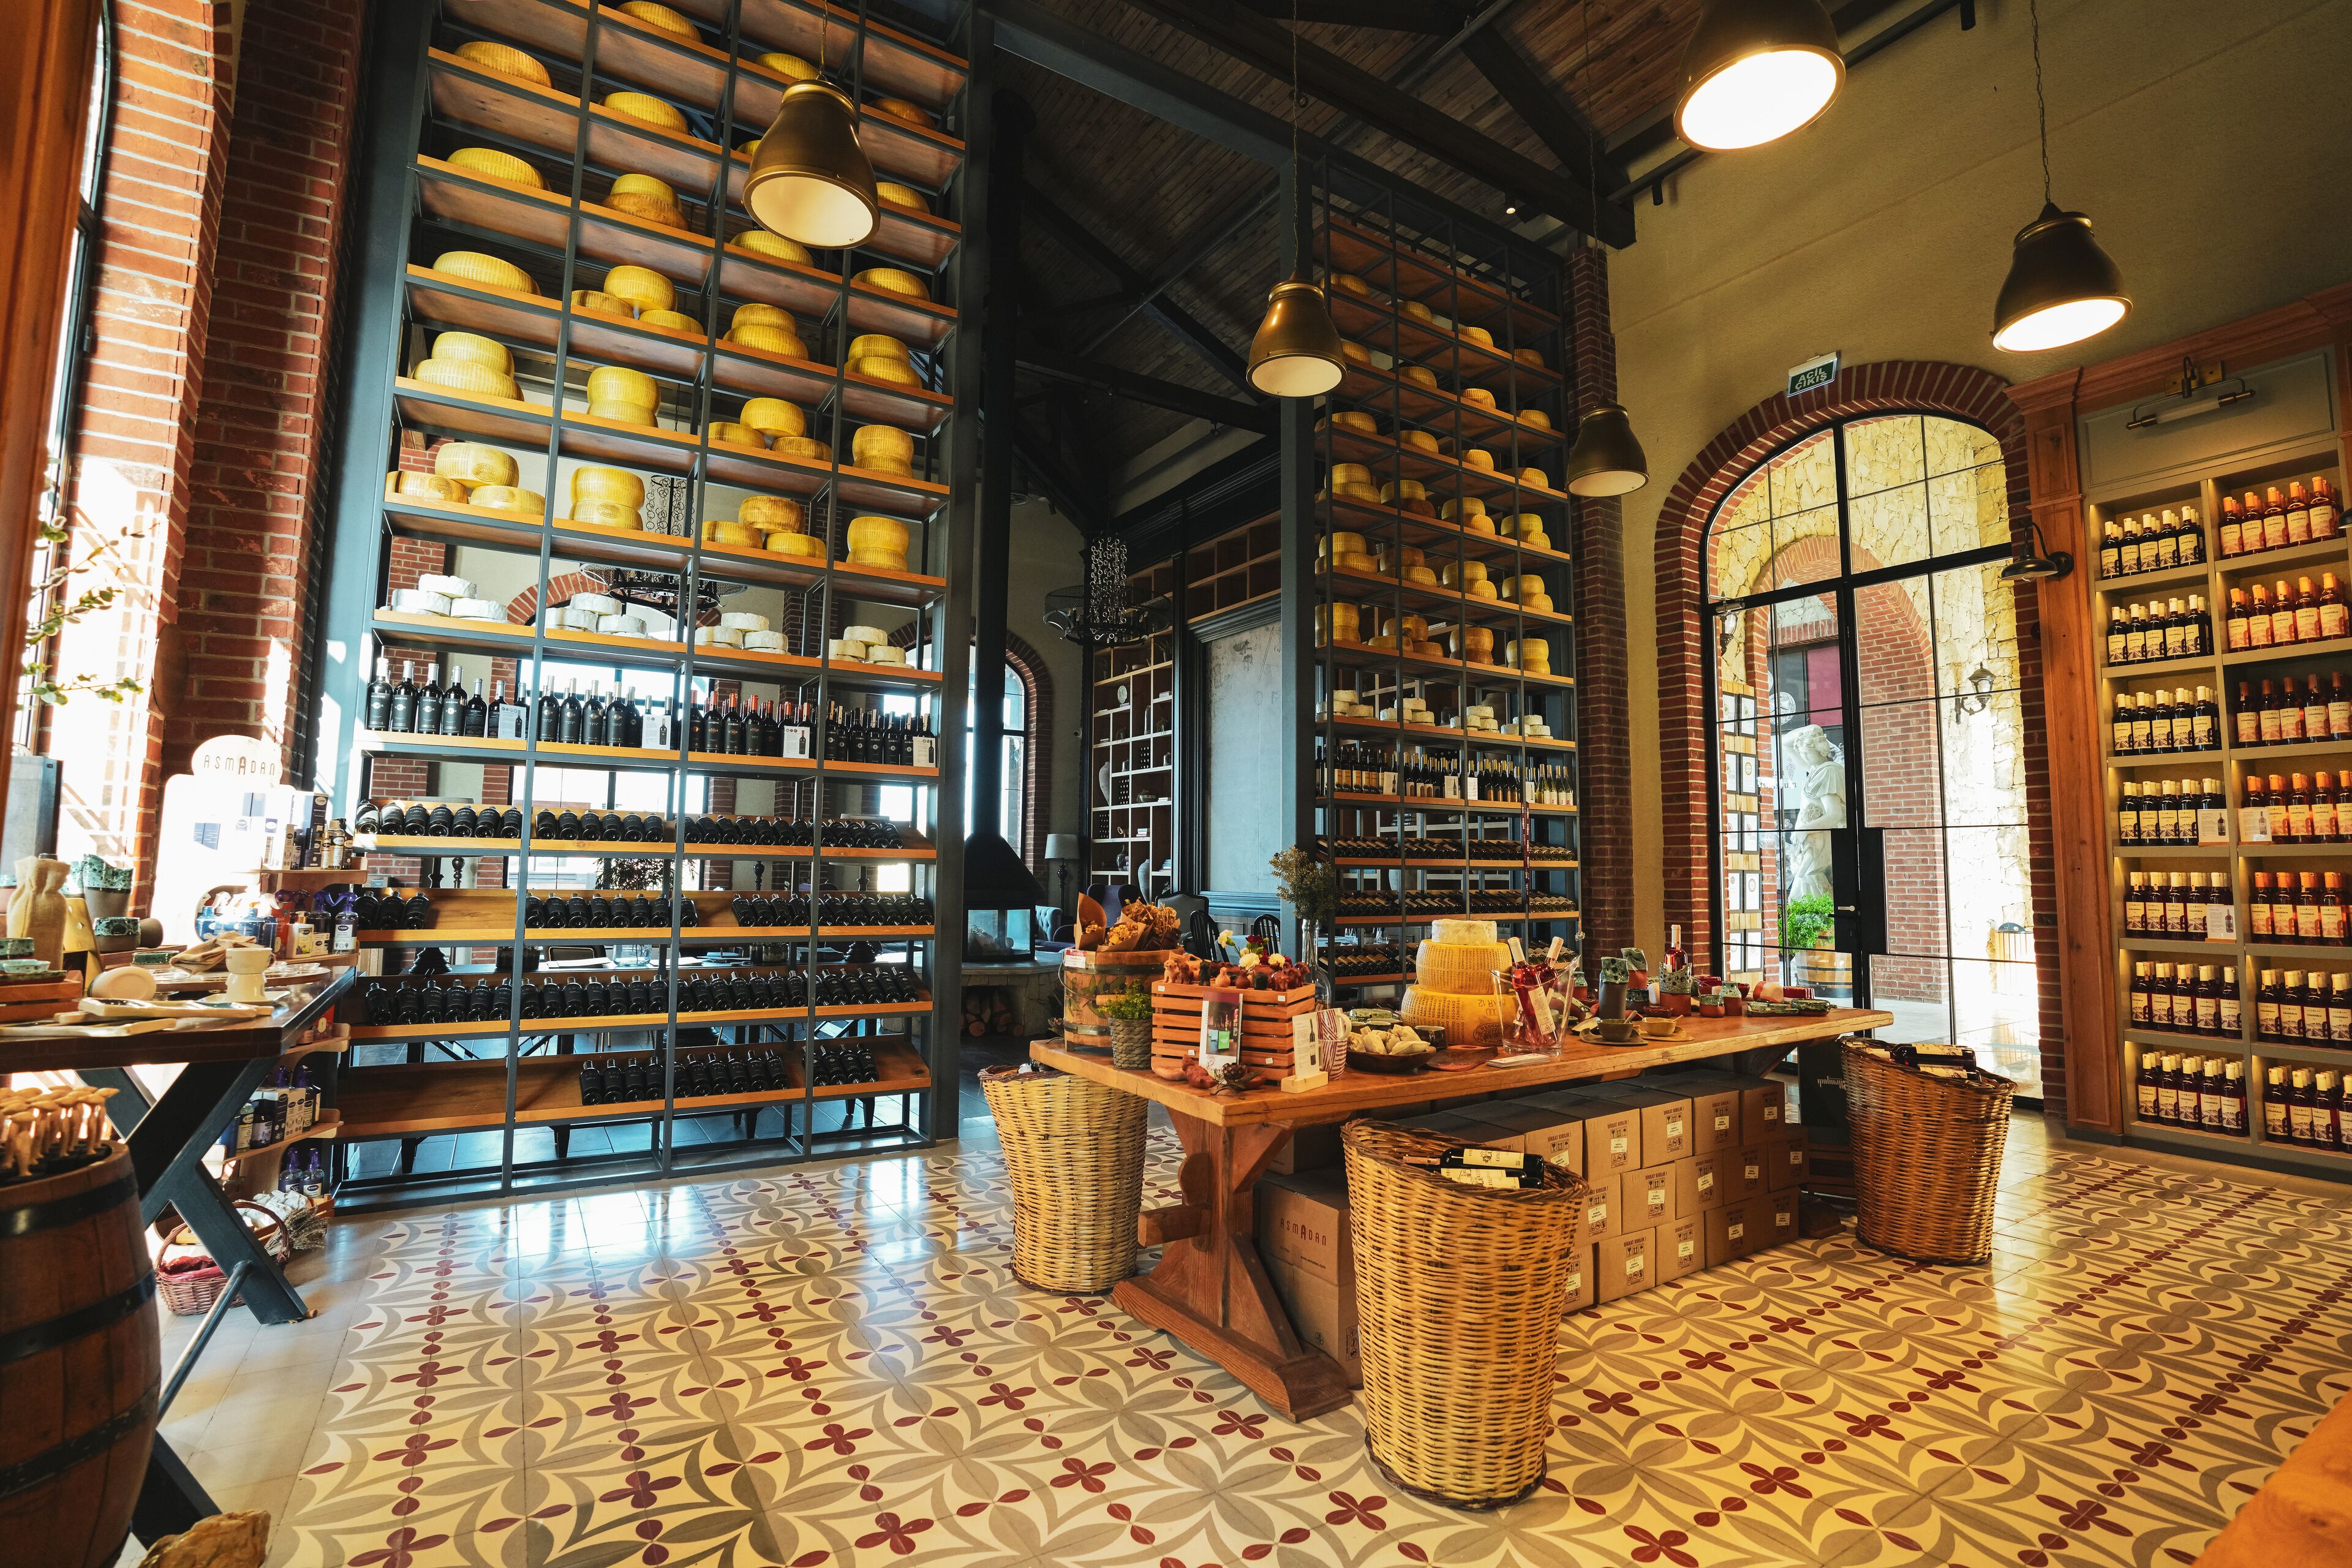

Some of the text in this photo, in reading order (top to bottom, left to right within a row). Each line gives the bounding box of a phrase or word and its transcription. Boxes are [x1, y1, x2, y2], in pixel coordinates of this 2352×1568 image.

[1795, 372, 1827, 391] ÇIKIŞ
[1798, 368, 1825, 383] ACİL
[204, 755, 275, 775] ASMADAN
[1280, 1218, 1326, 1246] ASMADAN
